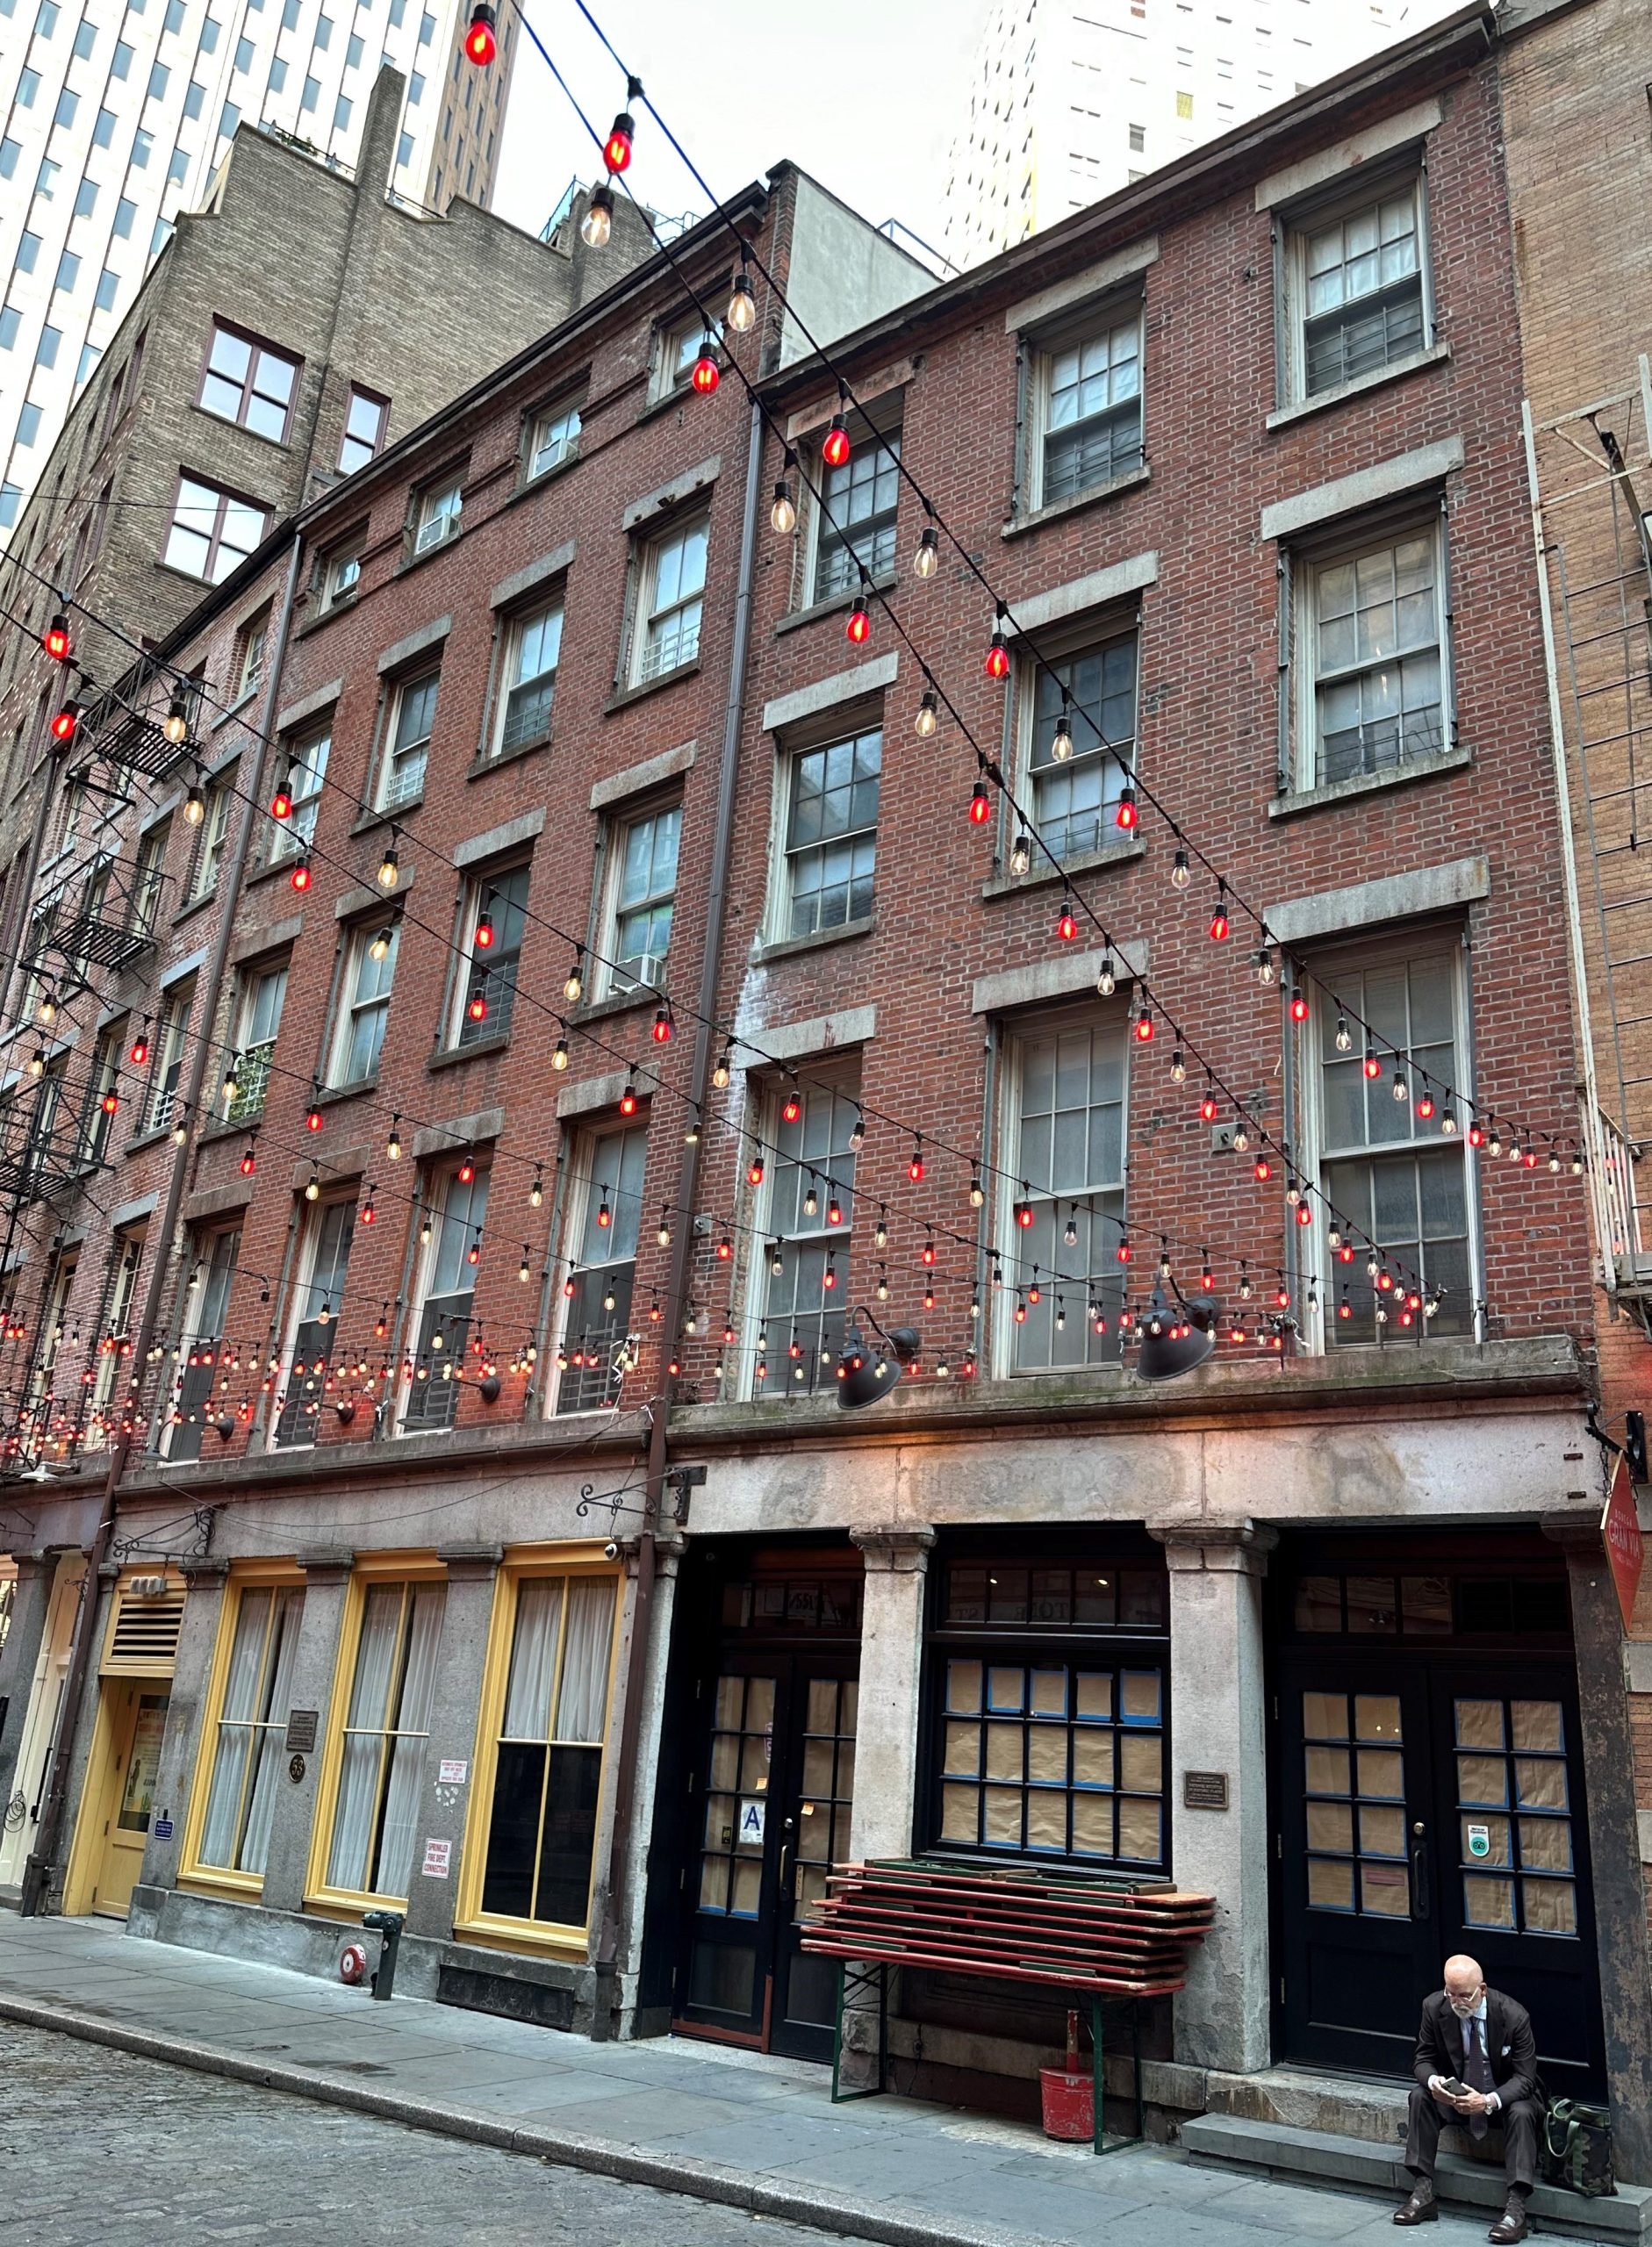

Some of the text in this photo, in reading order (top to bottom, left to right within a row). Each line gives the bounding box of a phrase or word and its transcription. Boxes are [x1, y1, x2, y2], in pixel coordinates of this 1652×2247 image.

[1608, 1518, 1627, 1552] GRAN
[1628, 1529, 1640, 1560] VIA
[291, 1759, 304, 1777] 53
[743, 1805, 760, 1830] A
[428, 1843, 449, 1853] SPRINKLER
[427, 1853, 436, 1862] FIRE
[424, 1863, 448, 1874] CONNECTION
